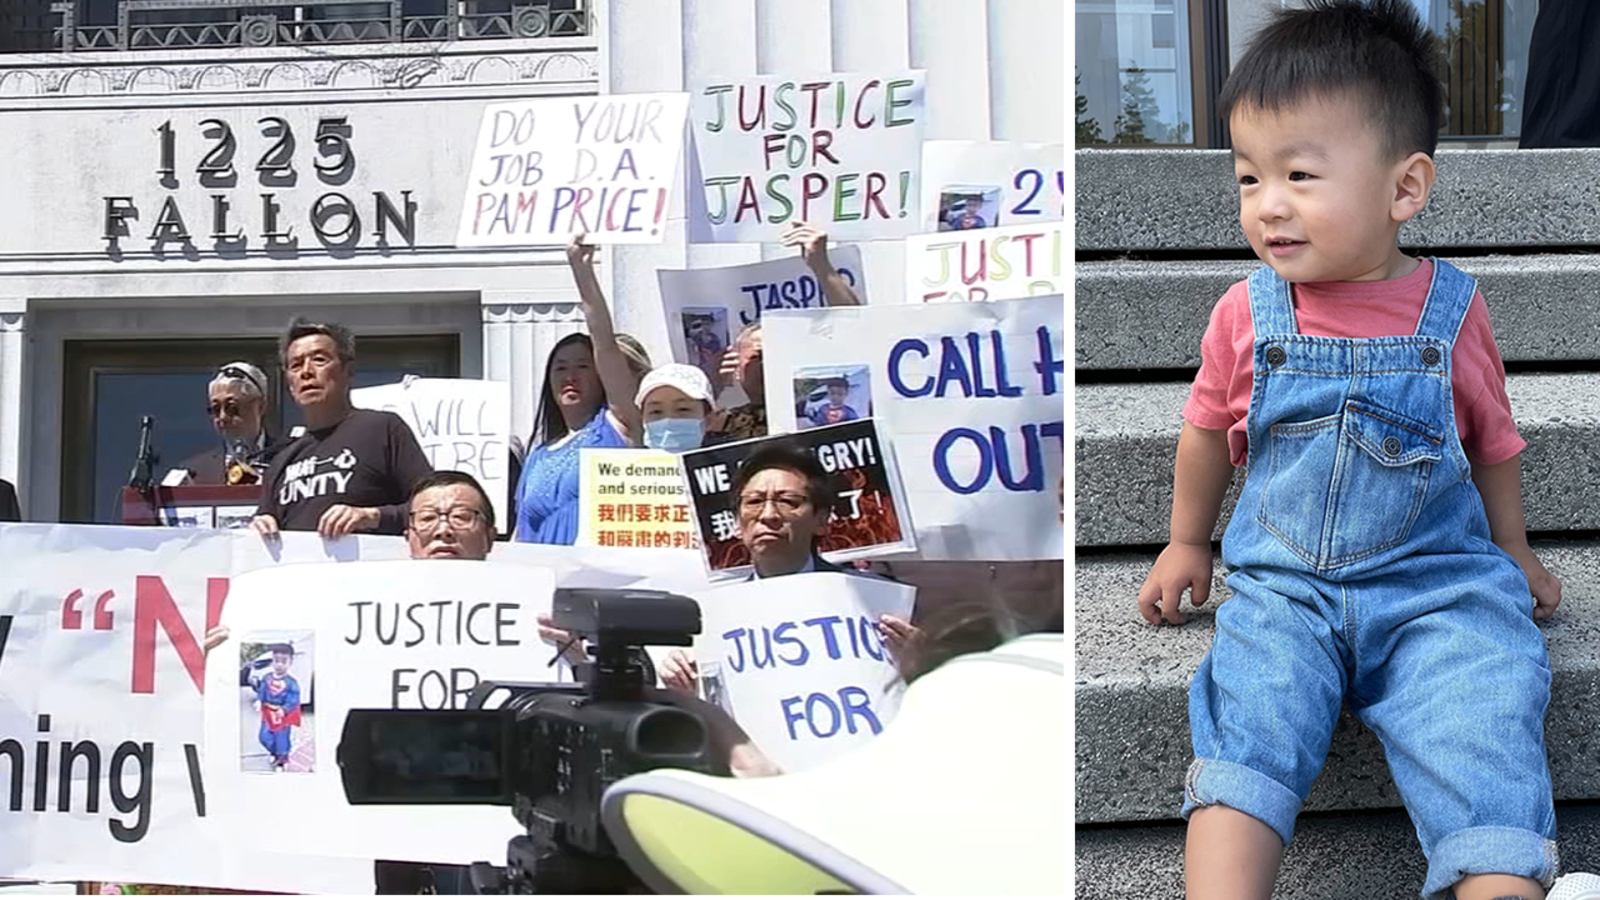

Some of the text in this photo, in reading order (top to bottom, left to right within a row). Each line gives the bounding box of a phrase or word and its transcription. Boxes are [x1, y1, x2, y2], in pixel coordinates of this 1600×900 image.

[490, 100, 664, 148] DO YOUR
[704, 80, 914, 132] JUSTICE
[155, 117, 356, 178] 1225
[479, 151, 543, 186] JOB
[763, 130, 839, 170] FOR
[101, 190, 416, 250] FALLON
[472, 187, 667, 236] PAM PRICE!
[704, 171, 909, 225] JASPER!
[740, 269, 859, 327] JASP
[888, 330, 1022, 398] CALL
[411, 399, 497, 438] WILL
[453, 441, 502, 480] BE
[598, 463, 622, 476] We
[694, 437, 876, 495] WE GRY!
[279, 471, 354, 504] UNITY
[598, 482, 625, 495] and
[598, 504, 690, 522] 我們要求正
[345, 600, 521, 648] JUSTICE
[722, 616, 893, 673] JUSTIC
[392, 668, 480, 710] FOR
[781, 686, 883, 740] FOR
